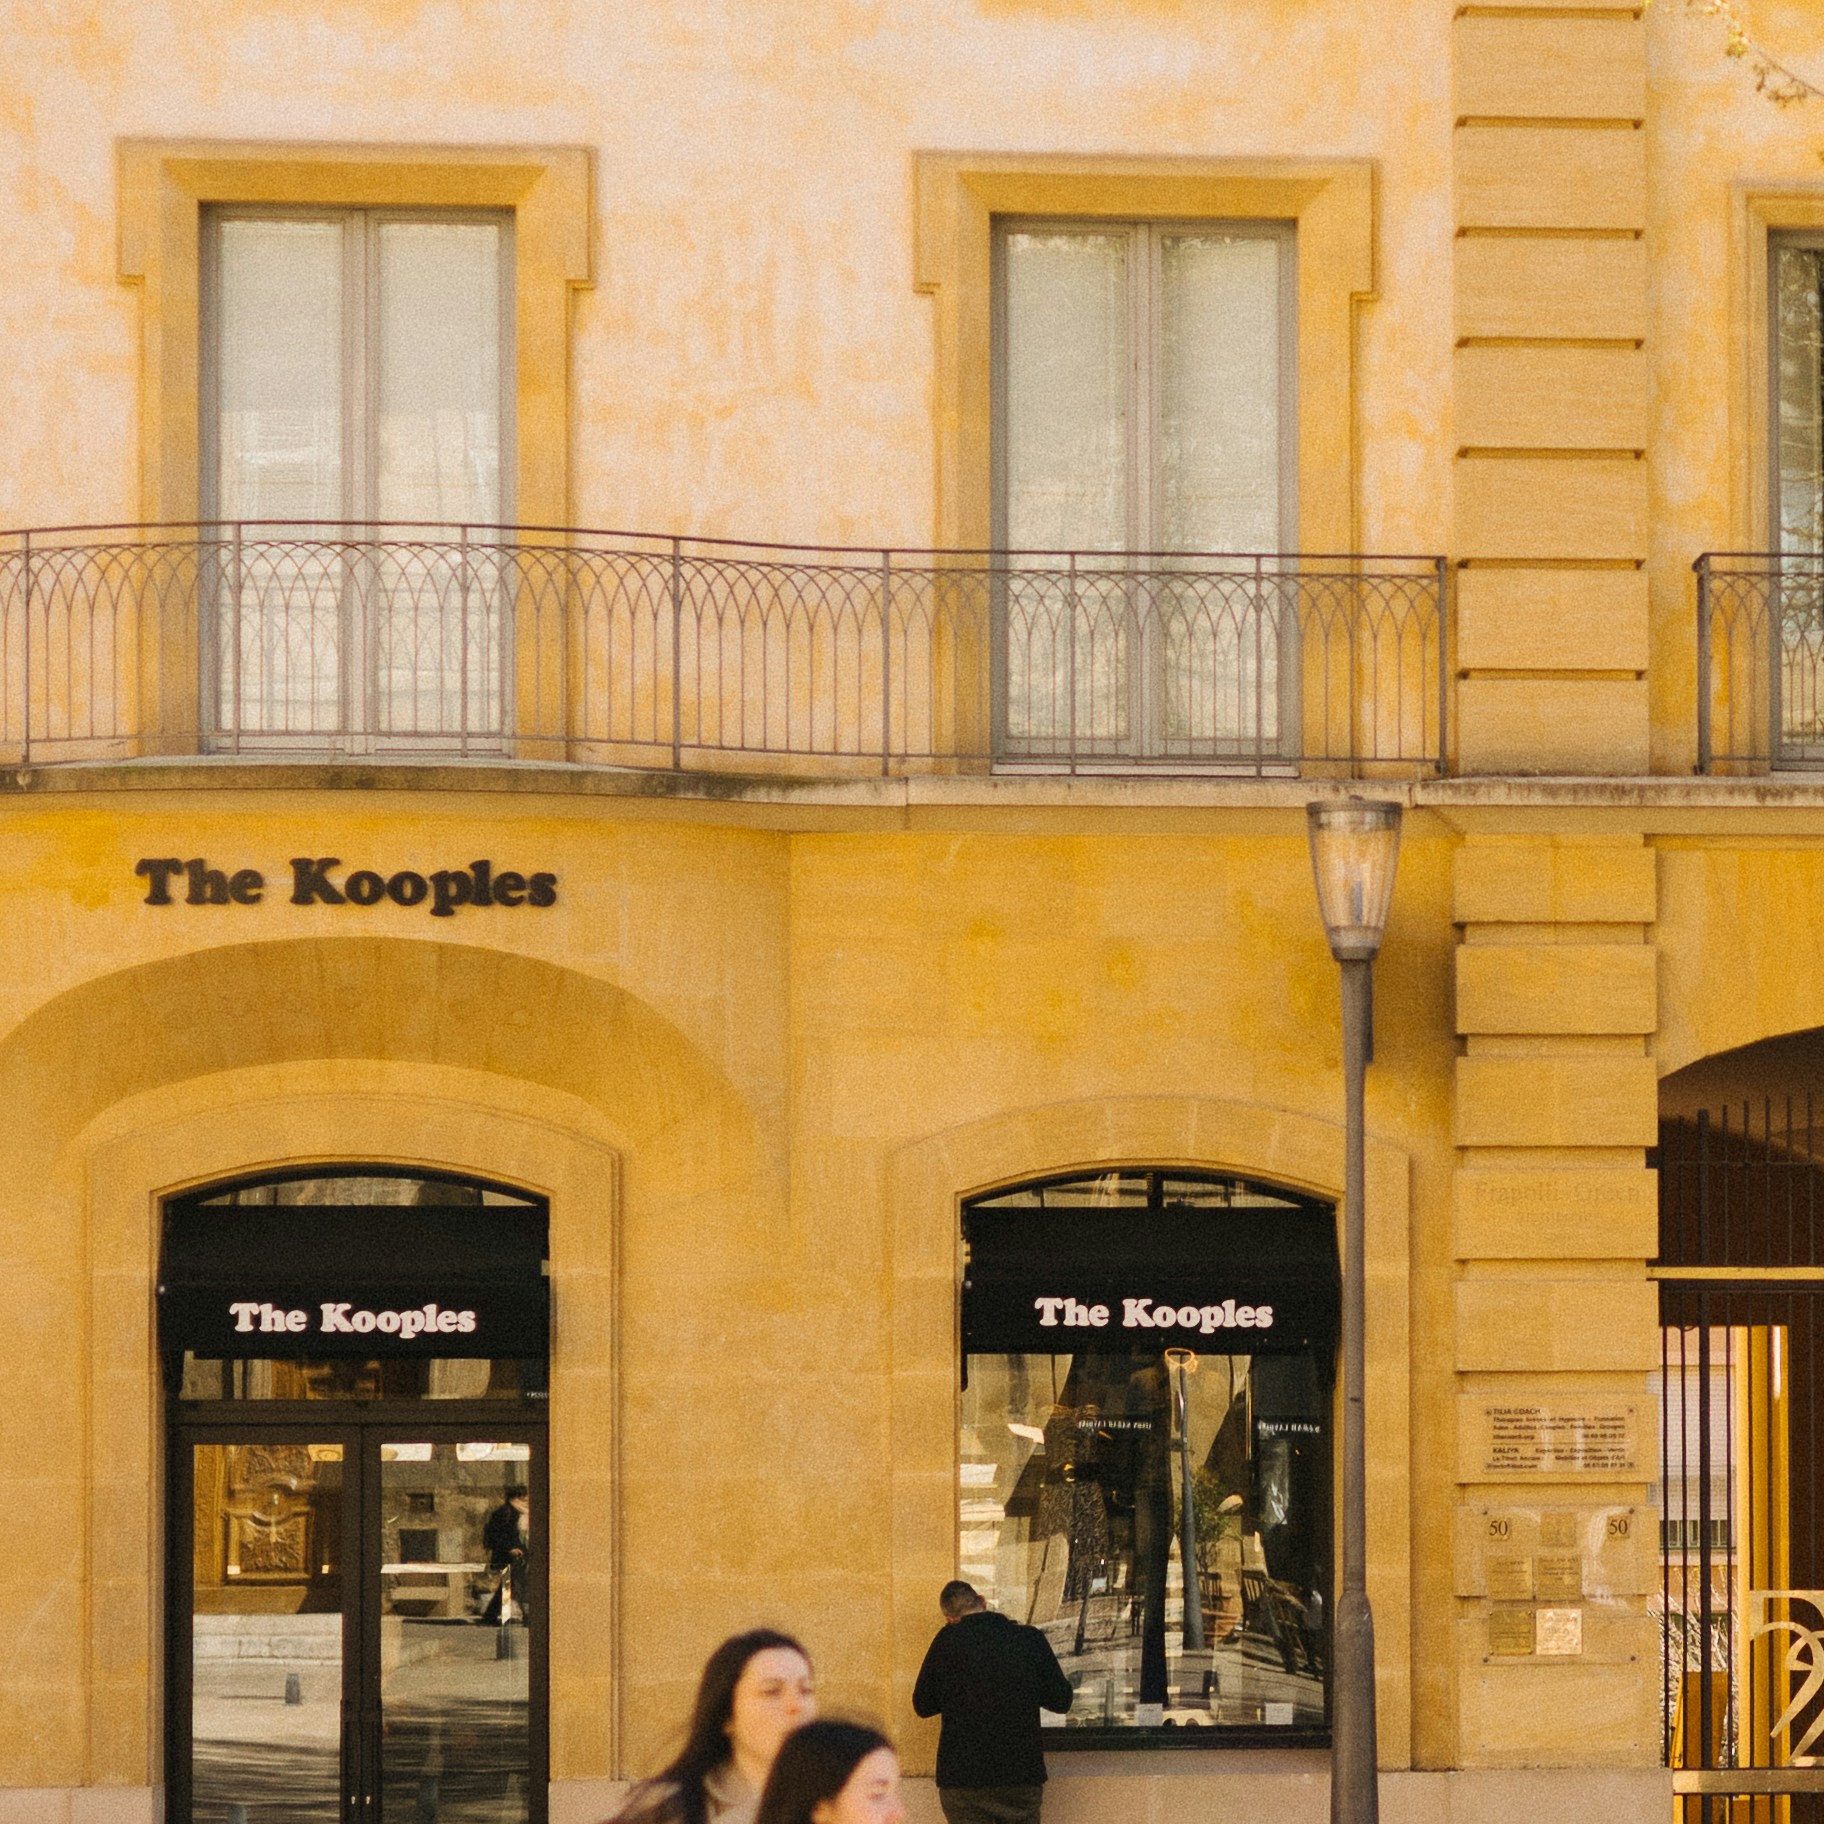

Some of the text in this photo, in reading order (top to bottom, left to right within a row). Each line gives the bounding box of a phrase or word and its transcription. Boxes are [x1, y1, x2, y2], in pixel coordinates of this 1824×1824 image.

[135, 858, 557, 917] The Kooples
[229, 1303, 477, 1340] The Kooples
[1034, 1298, 1274, 1335] The Kooples
[1489, 1520, 1508, 1536] 50
[1609, 1519, 1628, 1535] 50
